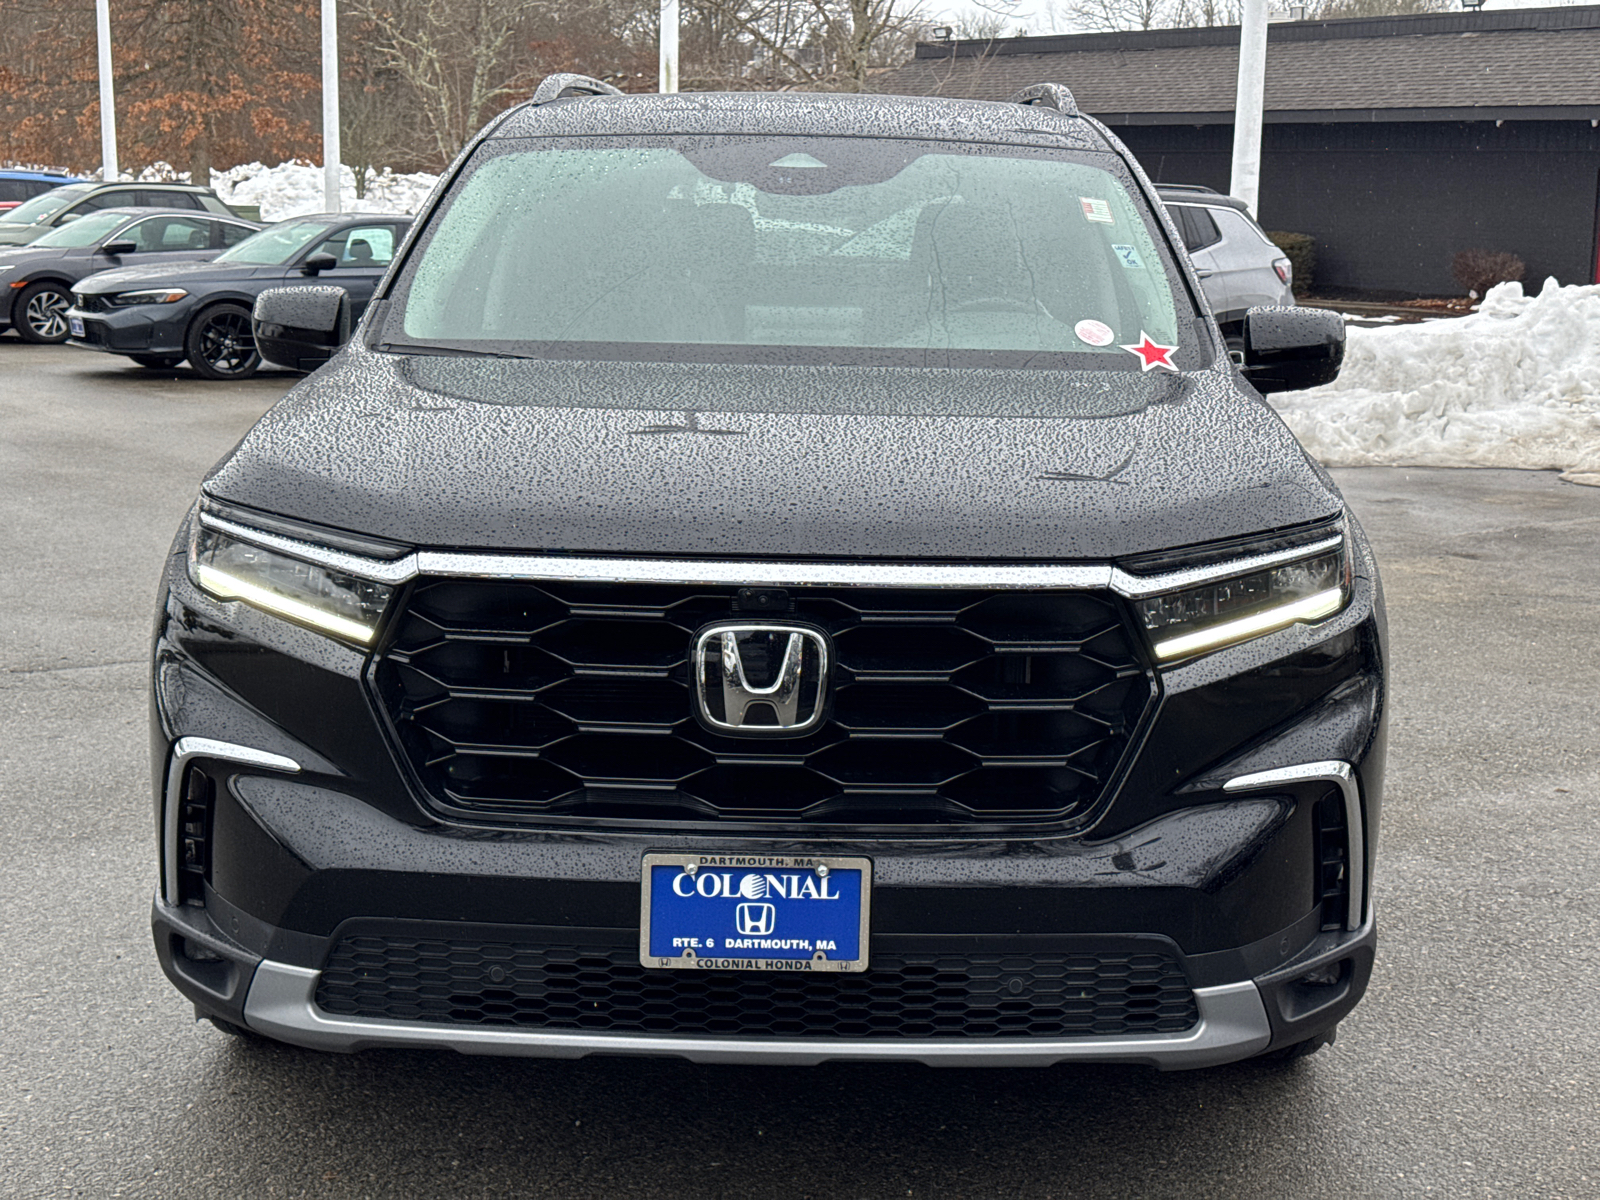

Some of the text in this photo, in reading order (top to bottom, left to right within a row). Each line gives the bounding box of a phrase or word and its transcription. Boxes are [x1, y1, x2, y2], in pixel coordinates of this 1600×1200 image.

[793, 858, 814, 867] MA
[672, 872, 840, 900] COLONIAL
[672, 937, 837, 951] RTE. 6 DARTMOUTH, MA
[696, 959, 812, 970] COLONIAL HONDA
